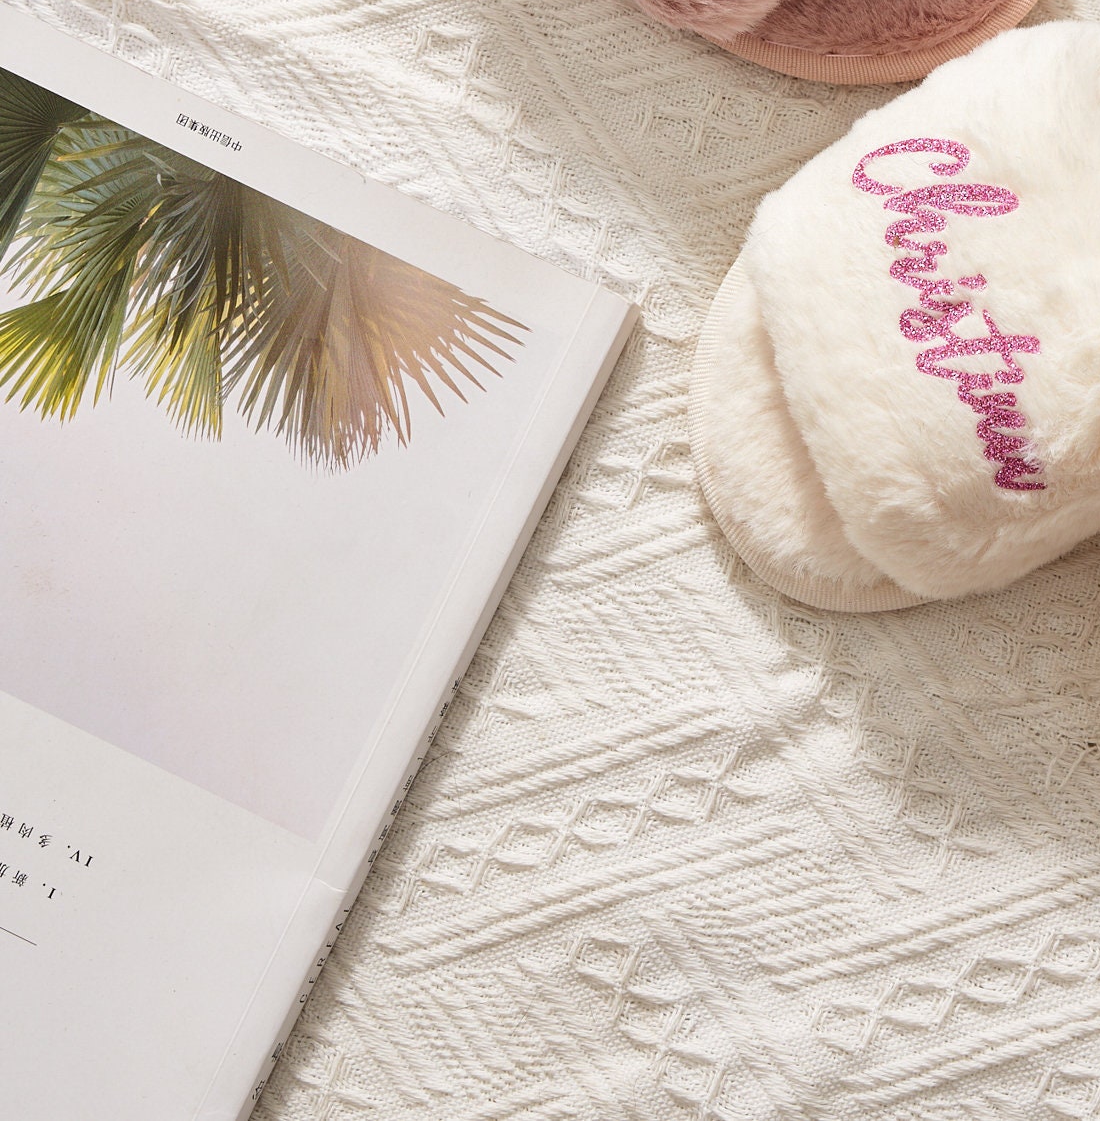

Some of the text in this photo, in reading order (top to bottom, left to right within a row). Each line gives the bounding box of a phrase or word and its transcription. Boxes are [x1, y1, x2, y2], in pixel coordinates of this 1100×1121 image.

[175, 113, 243, 152] 中信出版集团
[852, 138, 1046, 492] Christina
